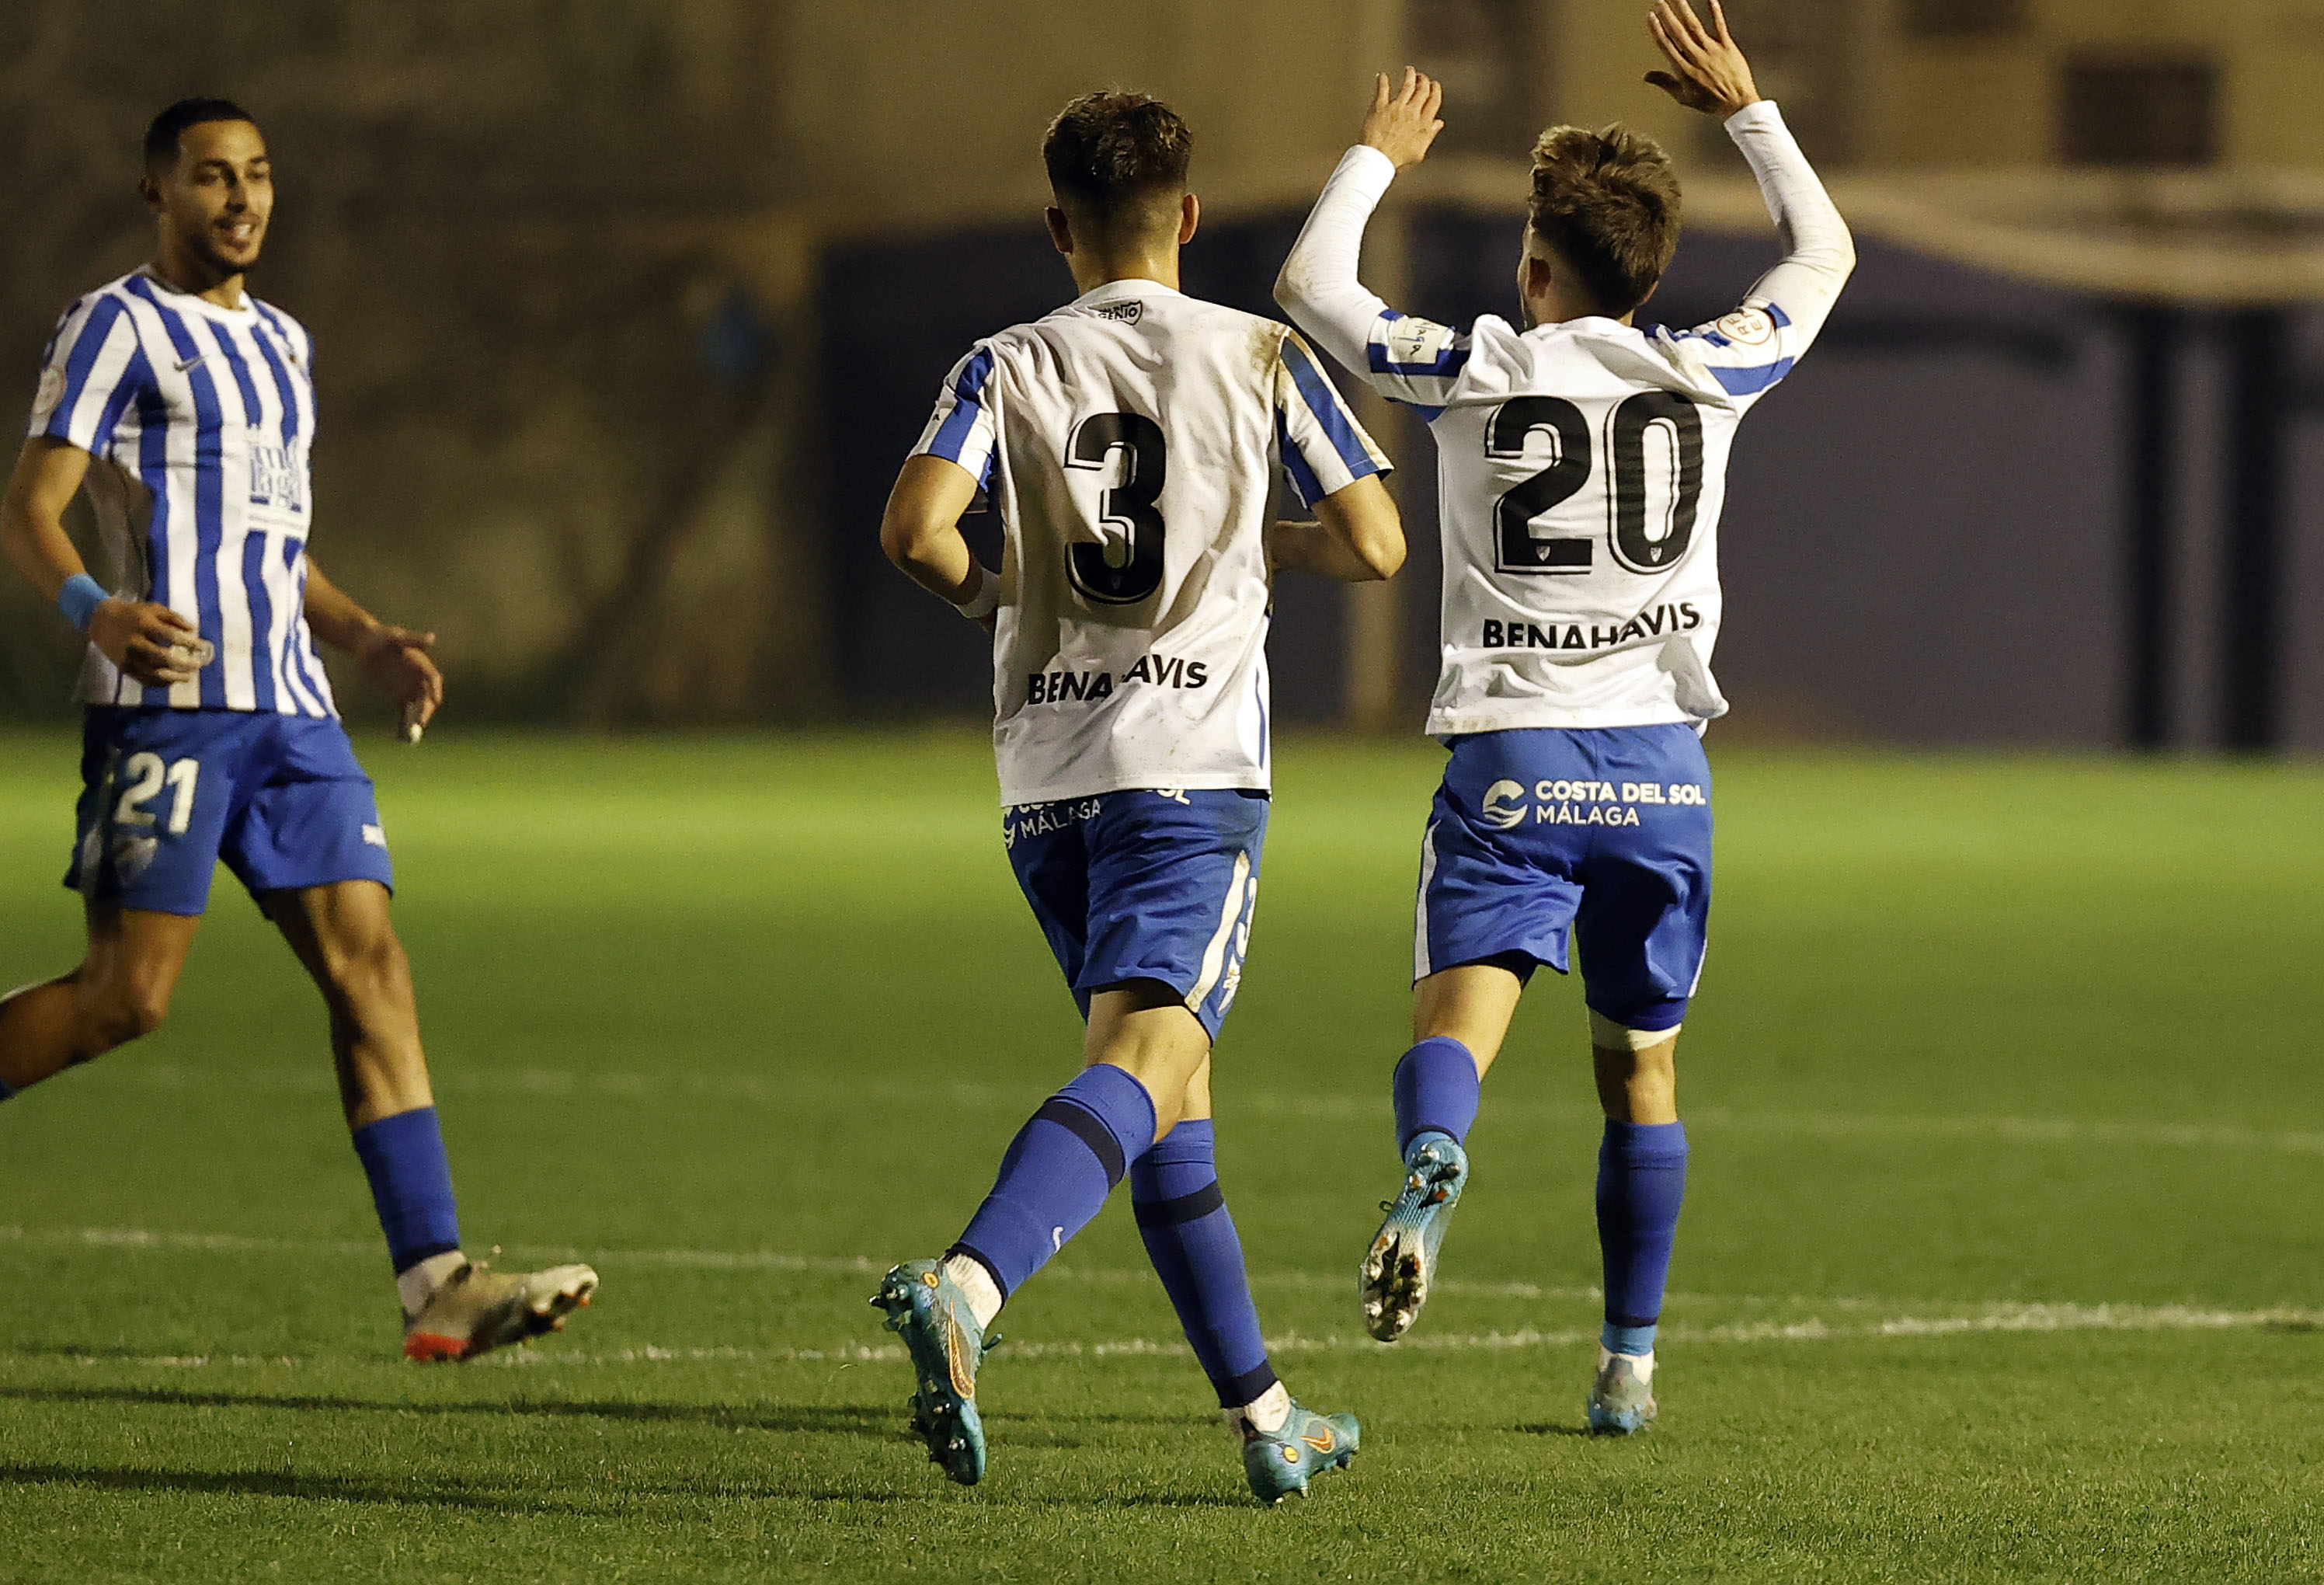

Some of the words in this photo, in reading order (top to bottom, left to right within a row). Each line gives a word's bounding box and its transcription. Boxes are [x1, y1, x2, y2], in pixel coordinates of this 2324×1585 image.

[1063, 412, 1166, 605] 3
[1484, 392, 1703, 575] 20
[1482, 601, 1701, 650] BENAHAVIS
[1027, 653, 1208, 705] BENAAVIS
[114, 751, 200, 834] 21
[1535, 779, 1618, 803] COSTA
[1621, 782, 1666, 804] DEL
[1668, 783, 1706, 806] SOL
[1536, 800, 1640, 827] MÁLAGA
